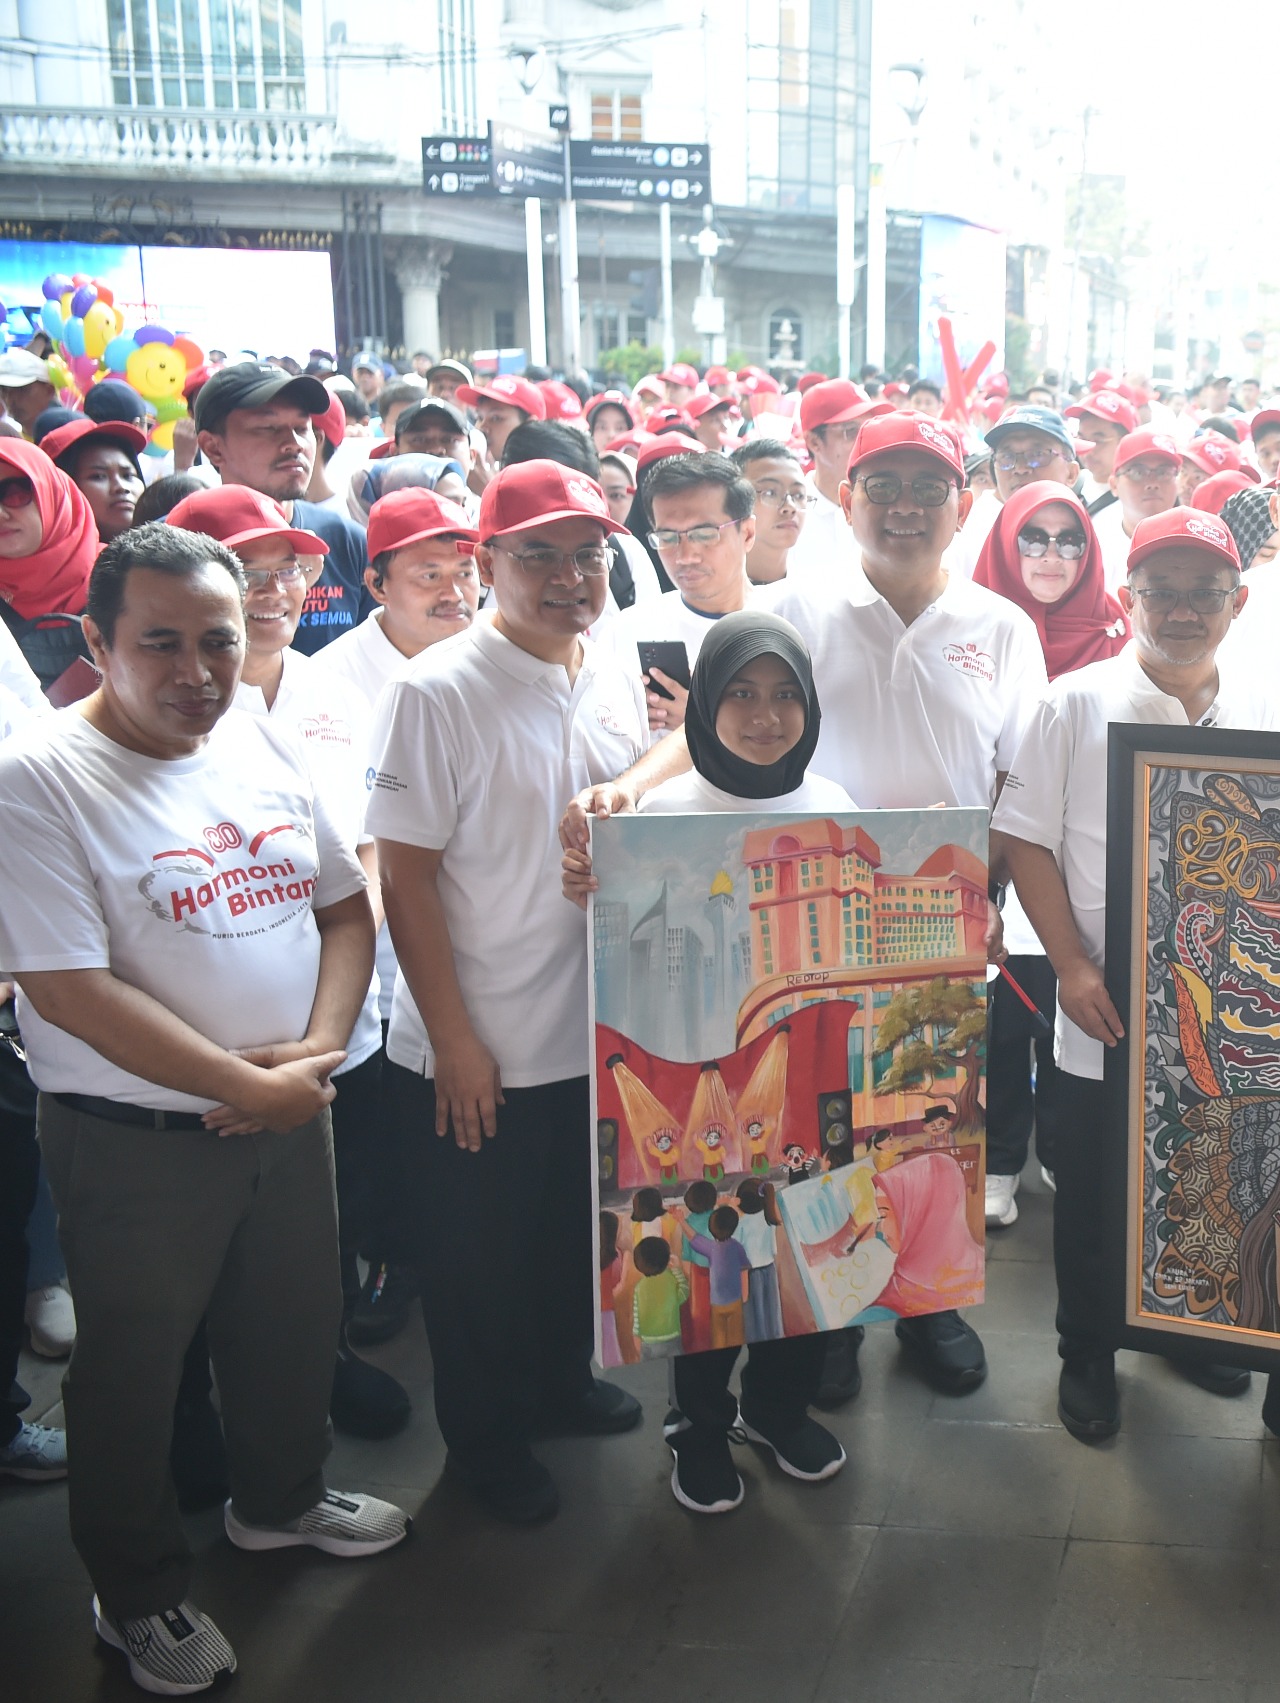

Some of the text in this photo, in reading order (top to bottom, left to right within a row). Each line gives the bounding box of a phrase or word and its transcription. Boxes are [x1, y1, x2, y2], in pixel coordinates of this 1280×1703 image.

[306, 586, 344, 599] DIKAN
[311, 612, 353, 626] SEMUA
[948, 654, 985, 668] Harmoni
[963, 662, 993, 681] Bintang
[203, 822, 242, 853] 80
[170, 858, 295, 922] Harmoni
[212, 931, 234, 940] MURID
[786, 971, 830, 987] REDTOP
[959, 1160, 977, 1171] ger
